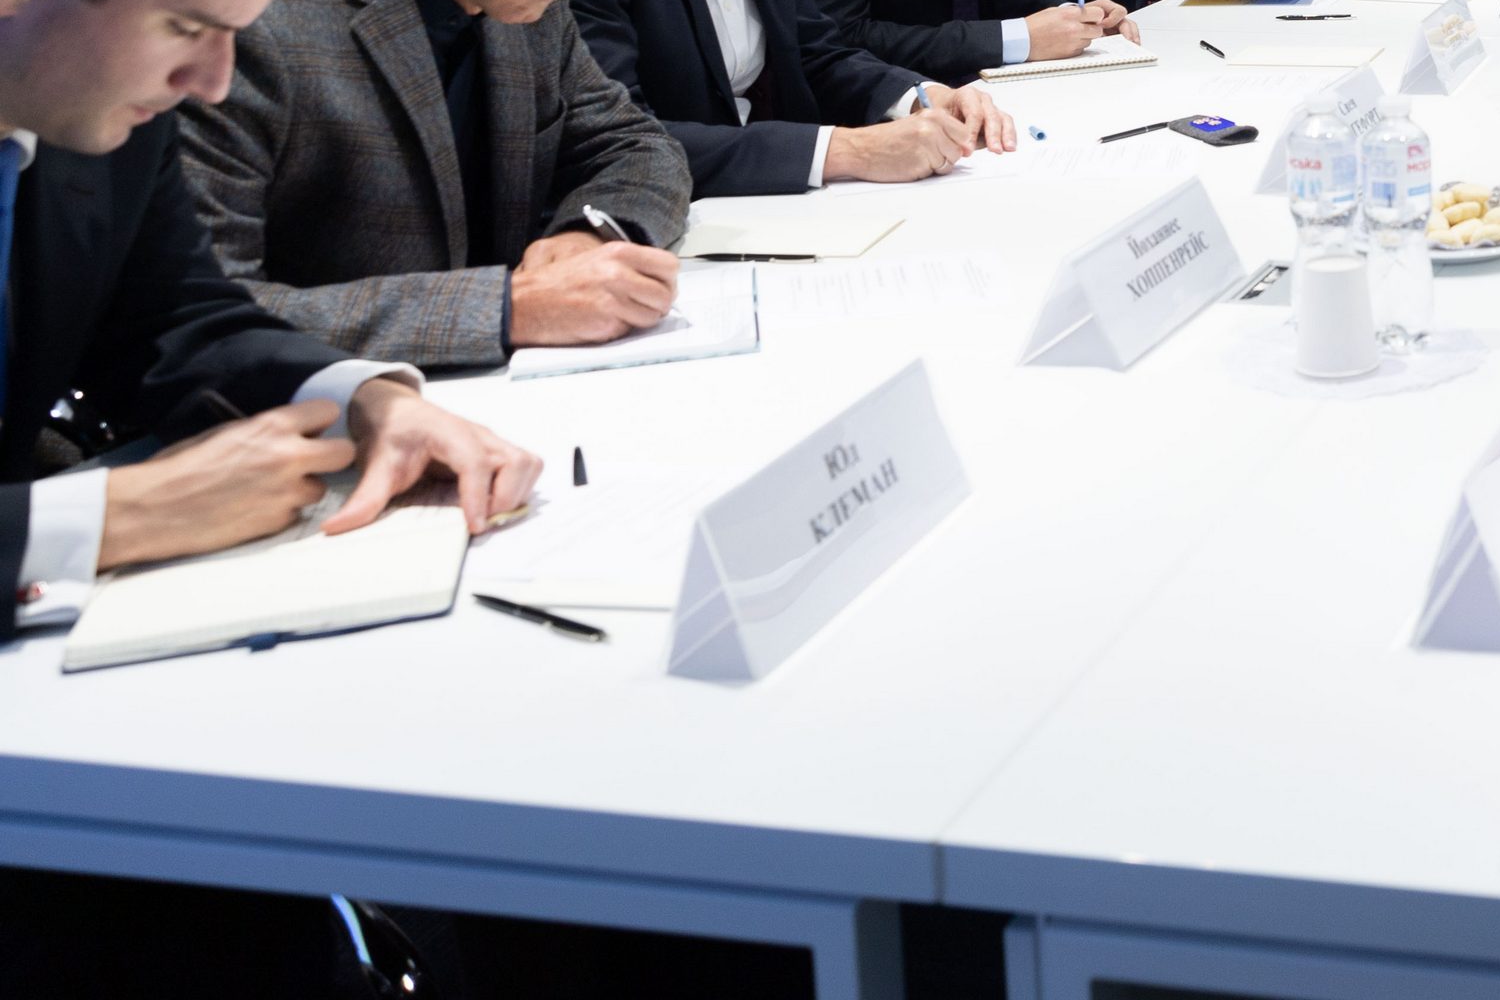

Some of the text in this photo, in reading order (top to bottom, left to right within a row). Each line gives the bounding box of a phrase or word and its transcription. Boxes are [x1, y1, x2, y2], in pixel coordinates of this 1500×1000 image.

[1126, 230, 1210, 302] ХОППЕНРЕЙС
[823, 444, 861, 480] Юл
[809, 457, 900, 544] КЛЕМАН
